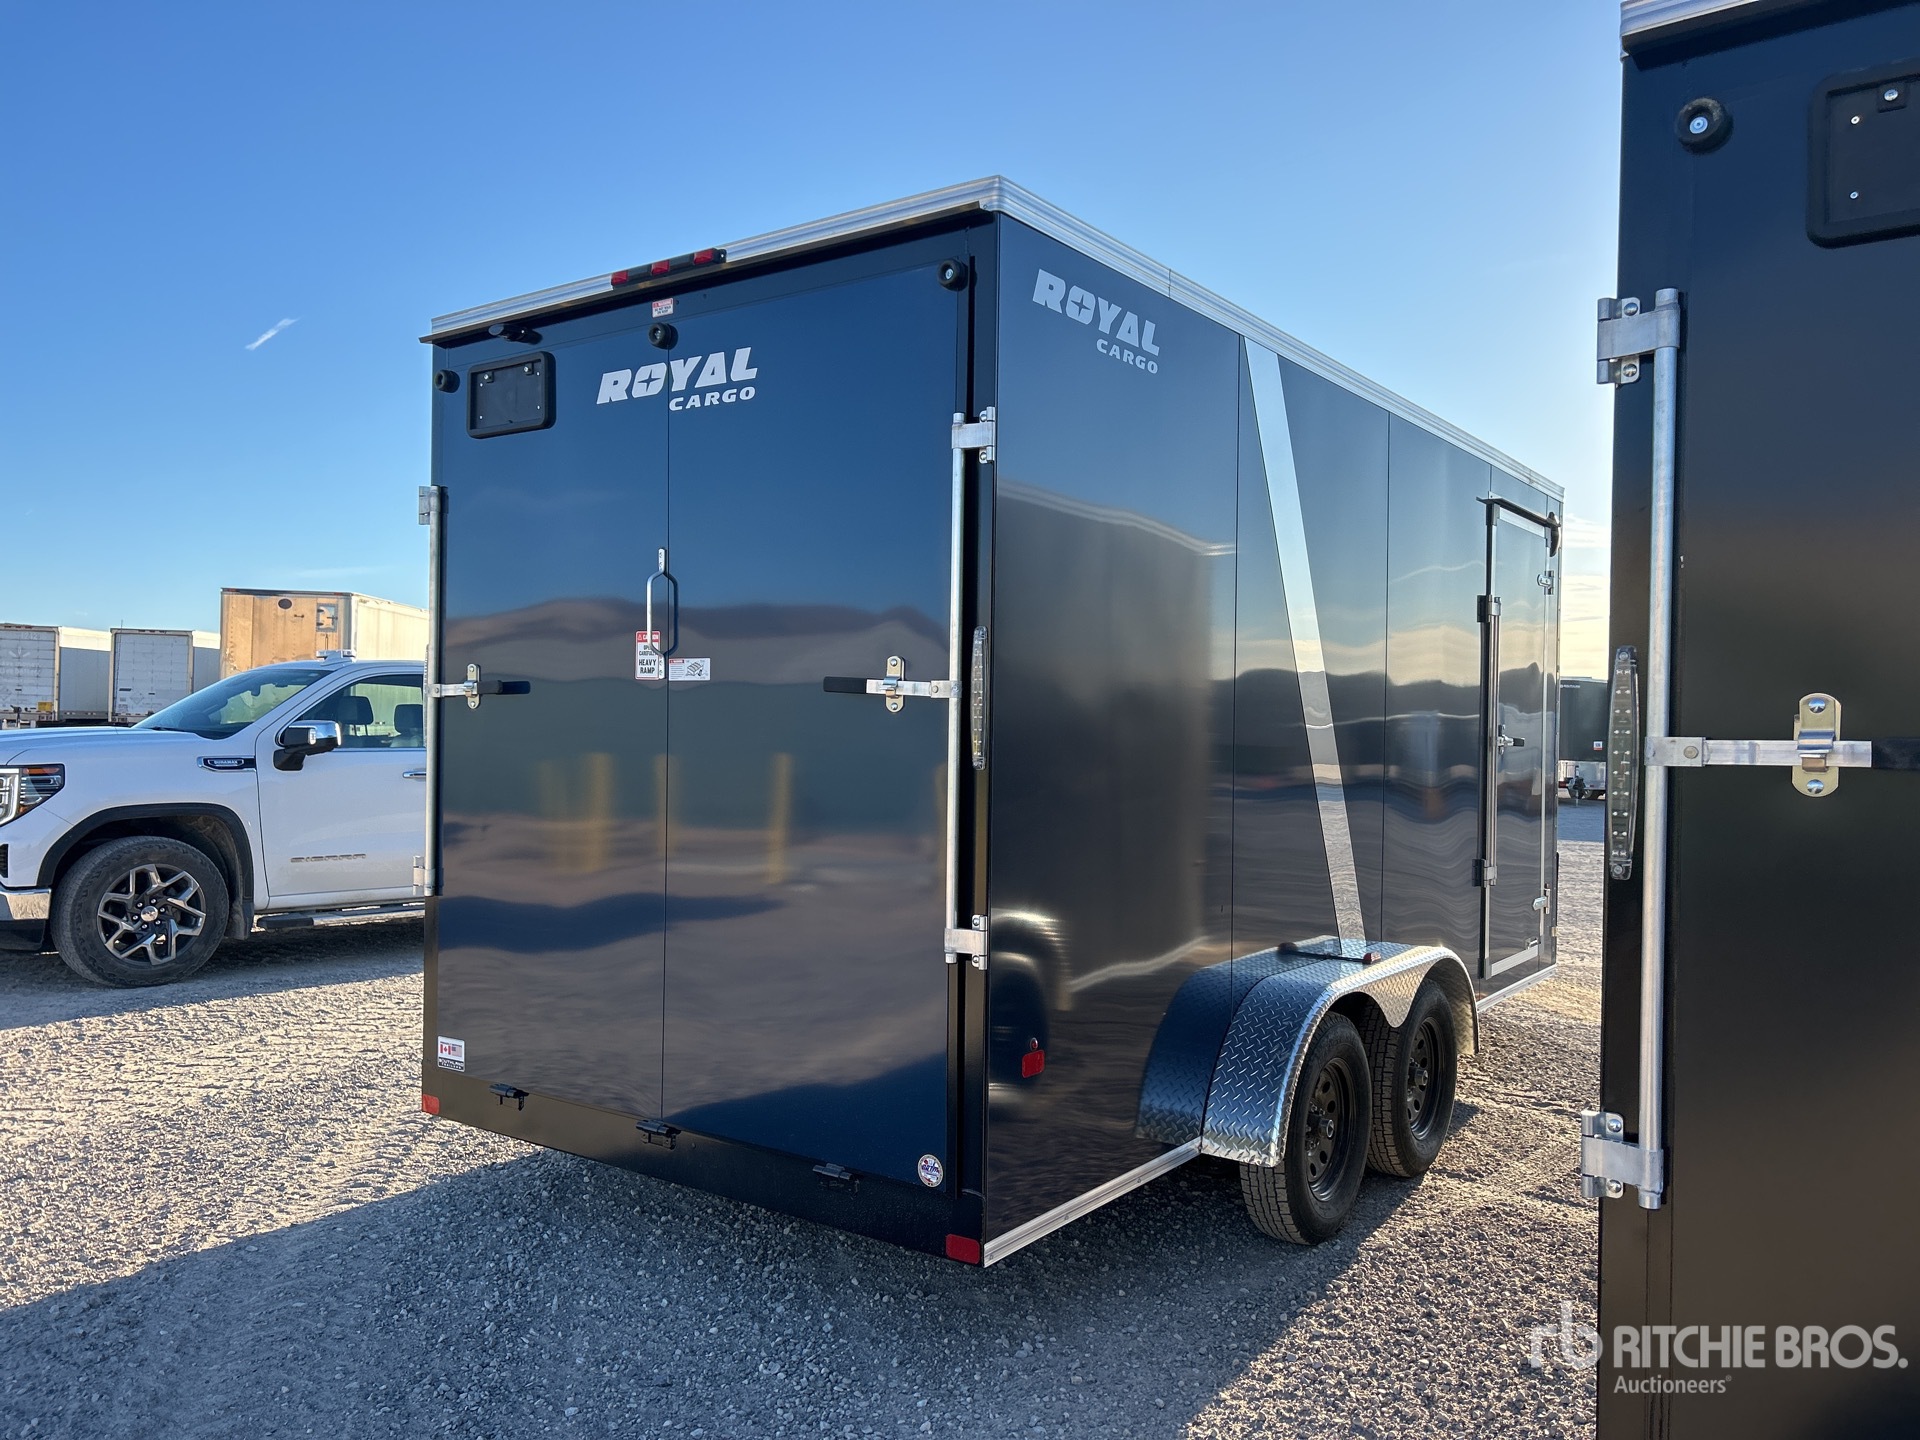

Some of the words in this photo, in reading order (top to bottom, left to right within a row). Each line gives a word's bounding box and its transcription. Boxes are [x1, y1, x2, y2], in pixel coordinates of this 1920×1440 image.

[1032, 268, 1160, 357] ROYAL
[596, 347, 758, 405] ROYAL
[1096, 338, 1158, 375] CARGO
[669, 386, 756, 411] CARGO
